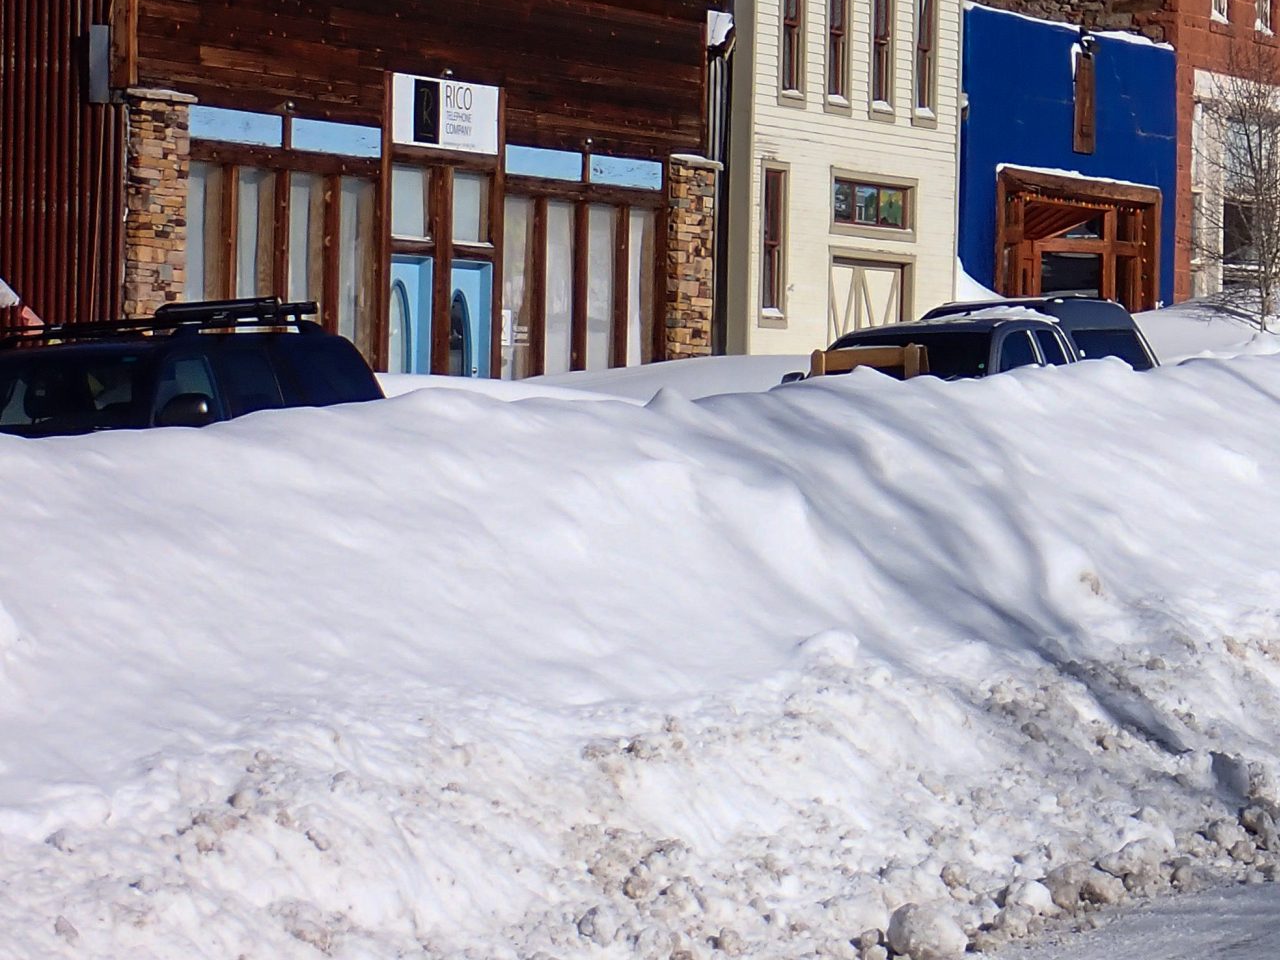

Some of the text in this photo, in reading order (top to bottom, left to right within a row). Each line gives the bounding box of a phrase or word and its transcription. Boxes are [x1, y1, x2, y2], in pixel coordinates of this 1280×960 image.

[445, 84, 472, 110] RICO
[446, 110, 472, 123] TELEPHONE
[445, 123, 472, 136] COMPANY
